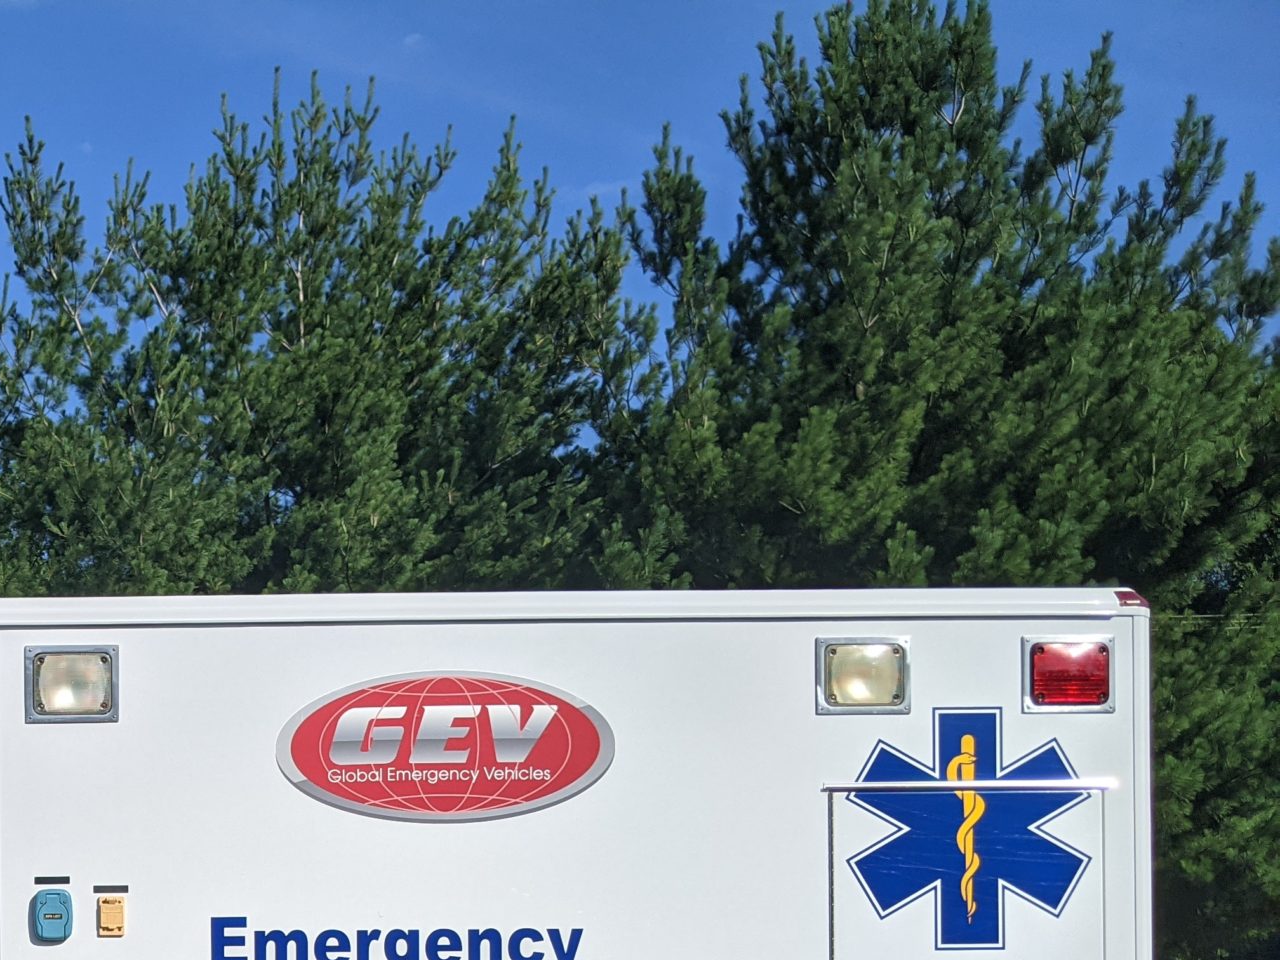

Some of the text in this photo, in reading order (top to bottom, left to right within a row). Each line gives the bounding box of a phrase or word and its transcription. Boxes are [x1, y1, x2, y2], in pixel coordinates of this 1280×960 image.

[329, 704, 558, 765] GEV
[328, 766, 551, 783] Global Emergency Vehicles
